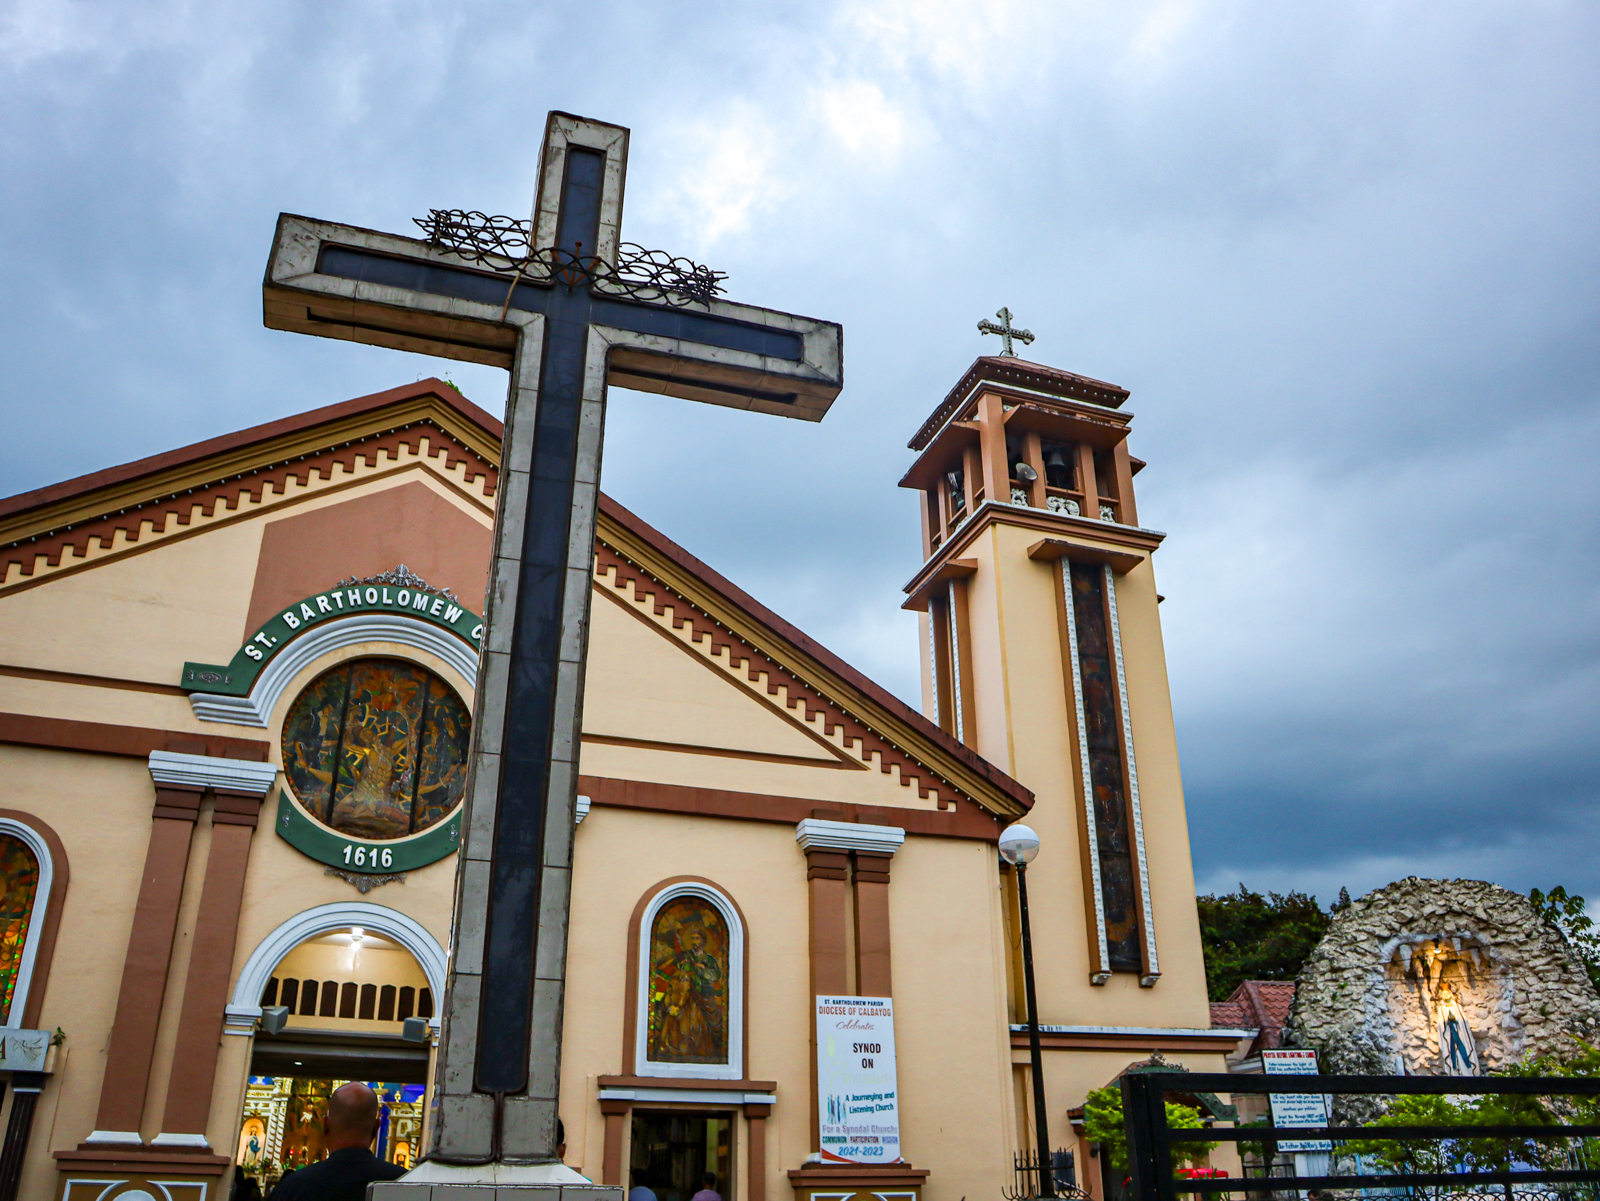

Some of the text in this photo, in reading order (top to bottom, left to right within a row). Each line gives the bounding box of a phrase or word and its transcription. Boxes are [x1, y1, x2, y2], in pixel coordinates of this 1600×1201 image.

[244, 631, 277, 662] ST.
[282, 587, 463, 630] BARTHOLOMEW
[343, 844, 393, 868] 1616
[819, 1006, 892, 1017] DIOCESE OF CALBAYOG
[836, 1019, 875, 1030] Celebrates
[853, 1043, 882, 1054] SYNOD
[862, 1058, 874, 1069] ON
[845, 1091, 895, 1102] A Journeying and
[849, 1103, 894, 1114] Listening Church
[822, 1125, 834, 1133] For
[842, 1124, 869, 1135] Synodal
[822, 1136, 898, 1144] COMMUNION PARTICIPATION MISSION
[838, 1146, 884, 1156] 2021-2023
